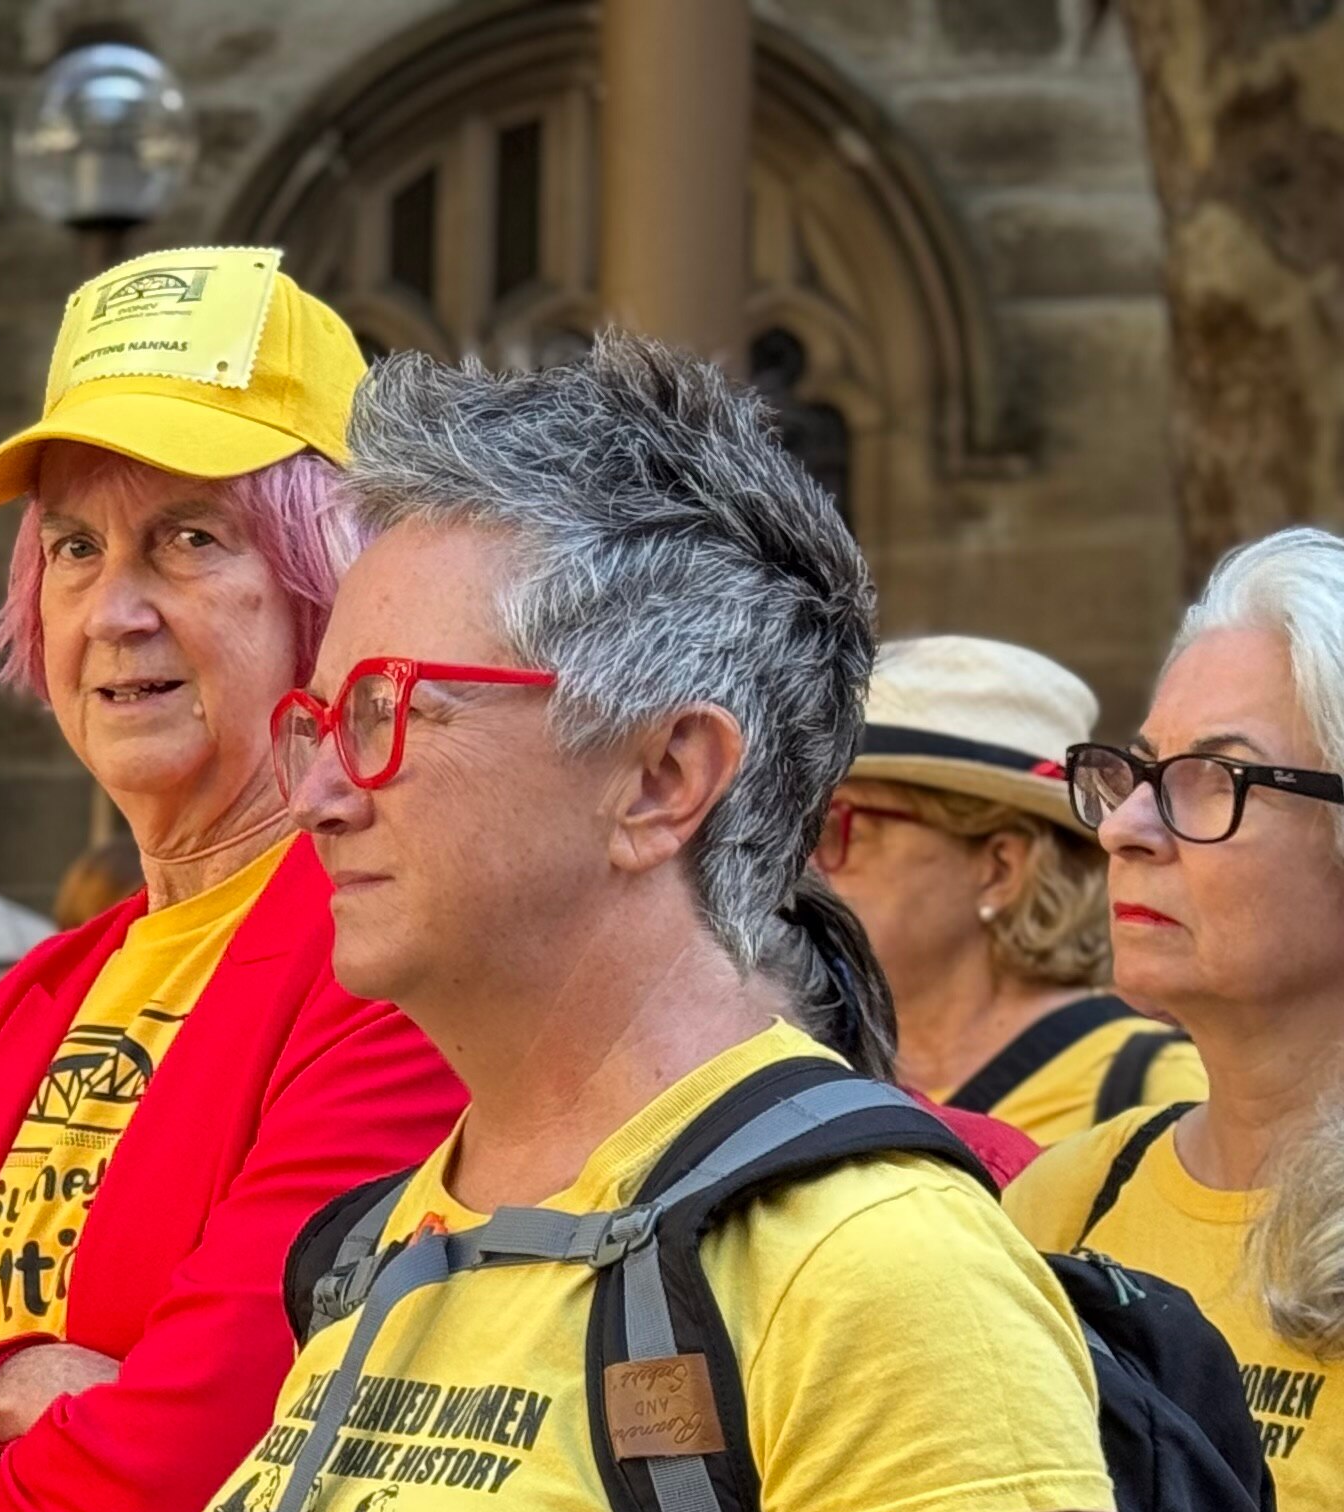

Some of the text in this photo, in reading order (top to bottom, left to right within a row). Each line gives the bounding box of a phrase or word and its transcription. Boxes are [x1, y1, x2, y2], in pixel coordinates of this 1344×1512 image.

[128, 341, 189, 353] NANNAS
[428, 1384, 553, 1452] WOMEN
[634, 1397, 669, 1416] AND
[1240, 1364, 1326, 1420] OMEN
[255, 1424, 522, 1495] SELD MAKE HISTORY
